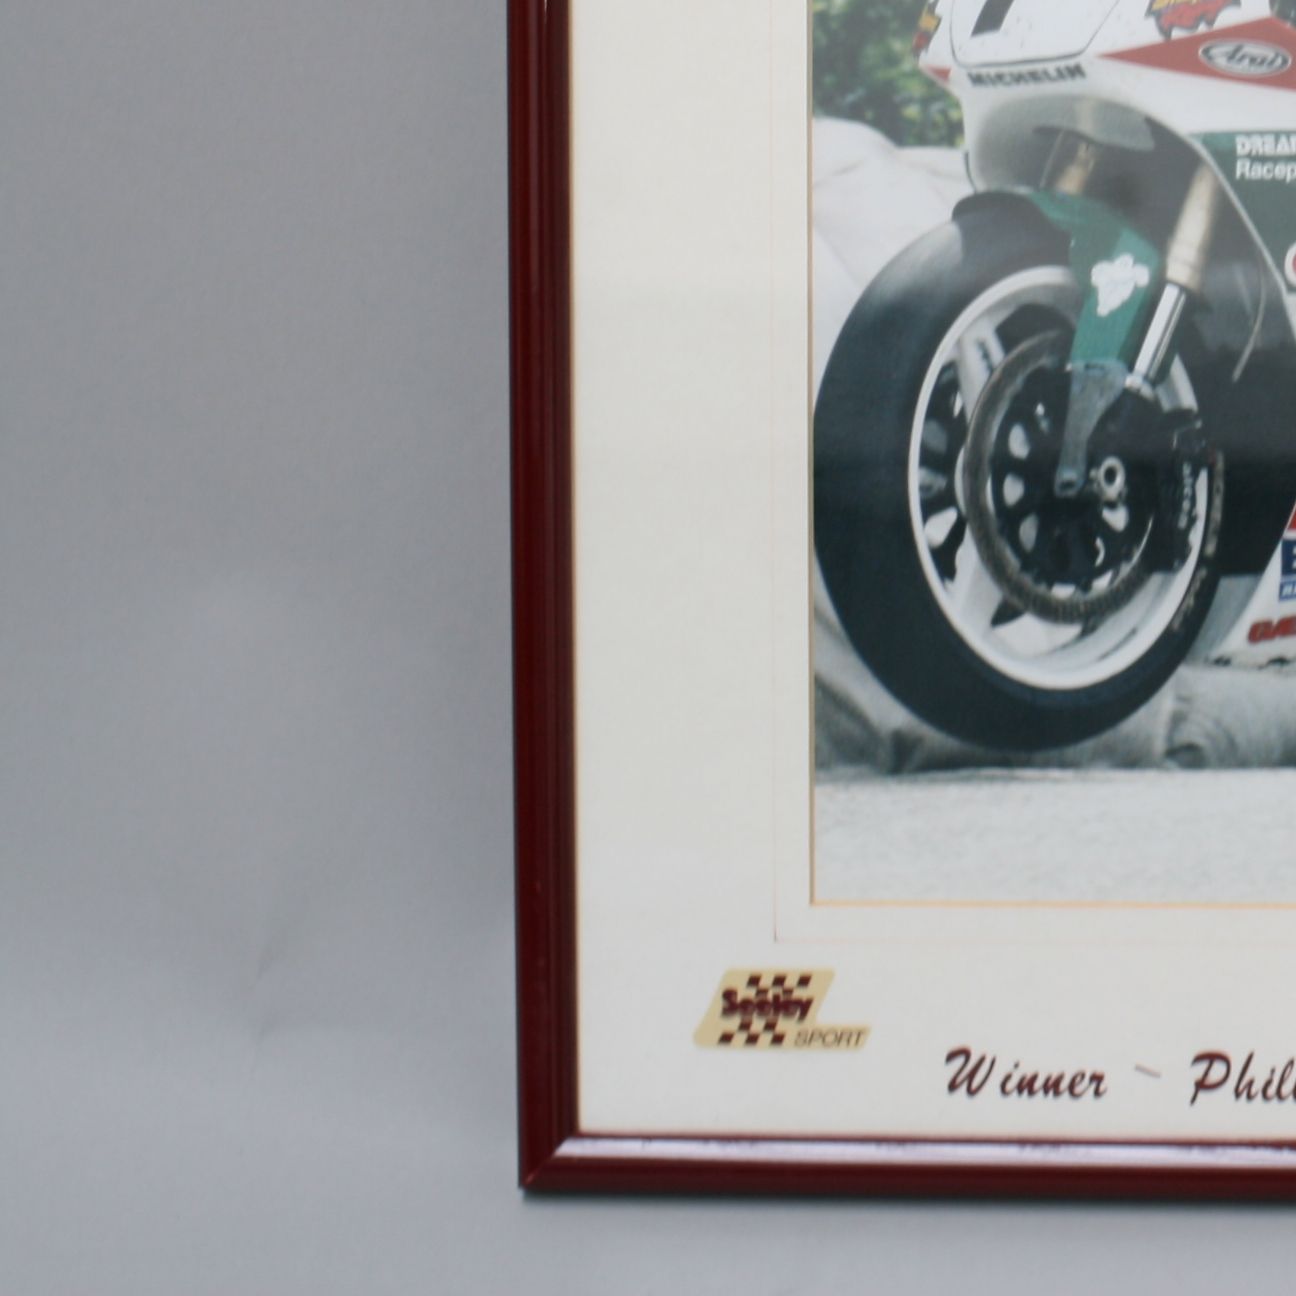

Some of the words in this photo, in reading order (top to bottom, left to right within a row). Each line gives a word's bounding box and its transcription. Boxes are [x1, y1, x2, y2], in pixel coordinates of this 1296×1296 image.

[966, 65, 1087, 87] MICHELIN
[794, 1028, 865, 1047] SPORT
[945, 1046, 1107, 1096] Winner
